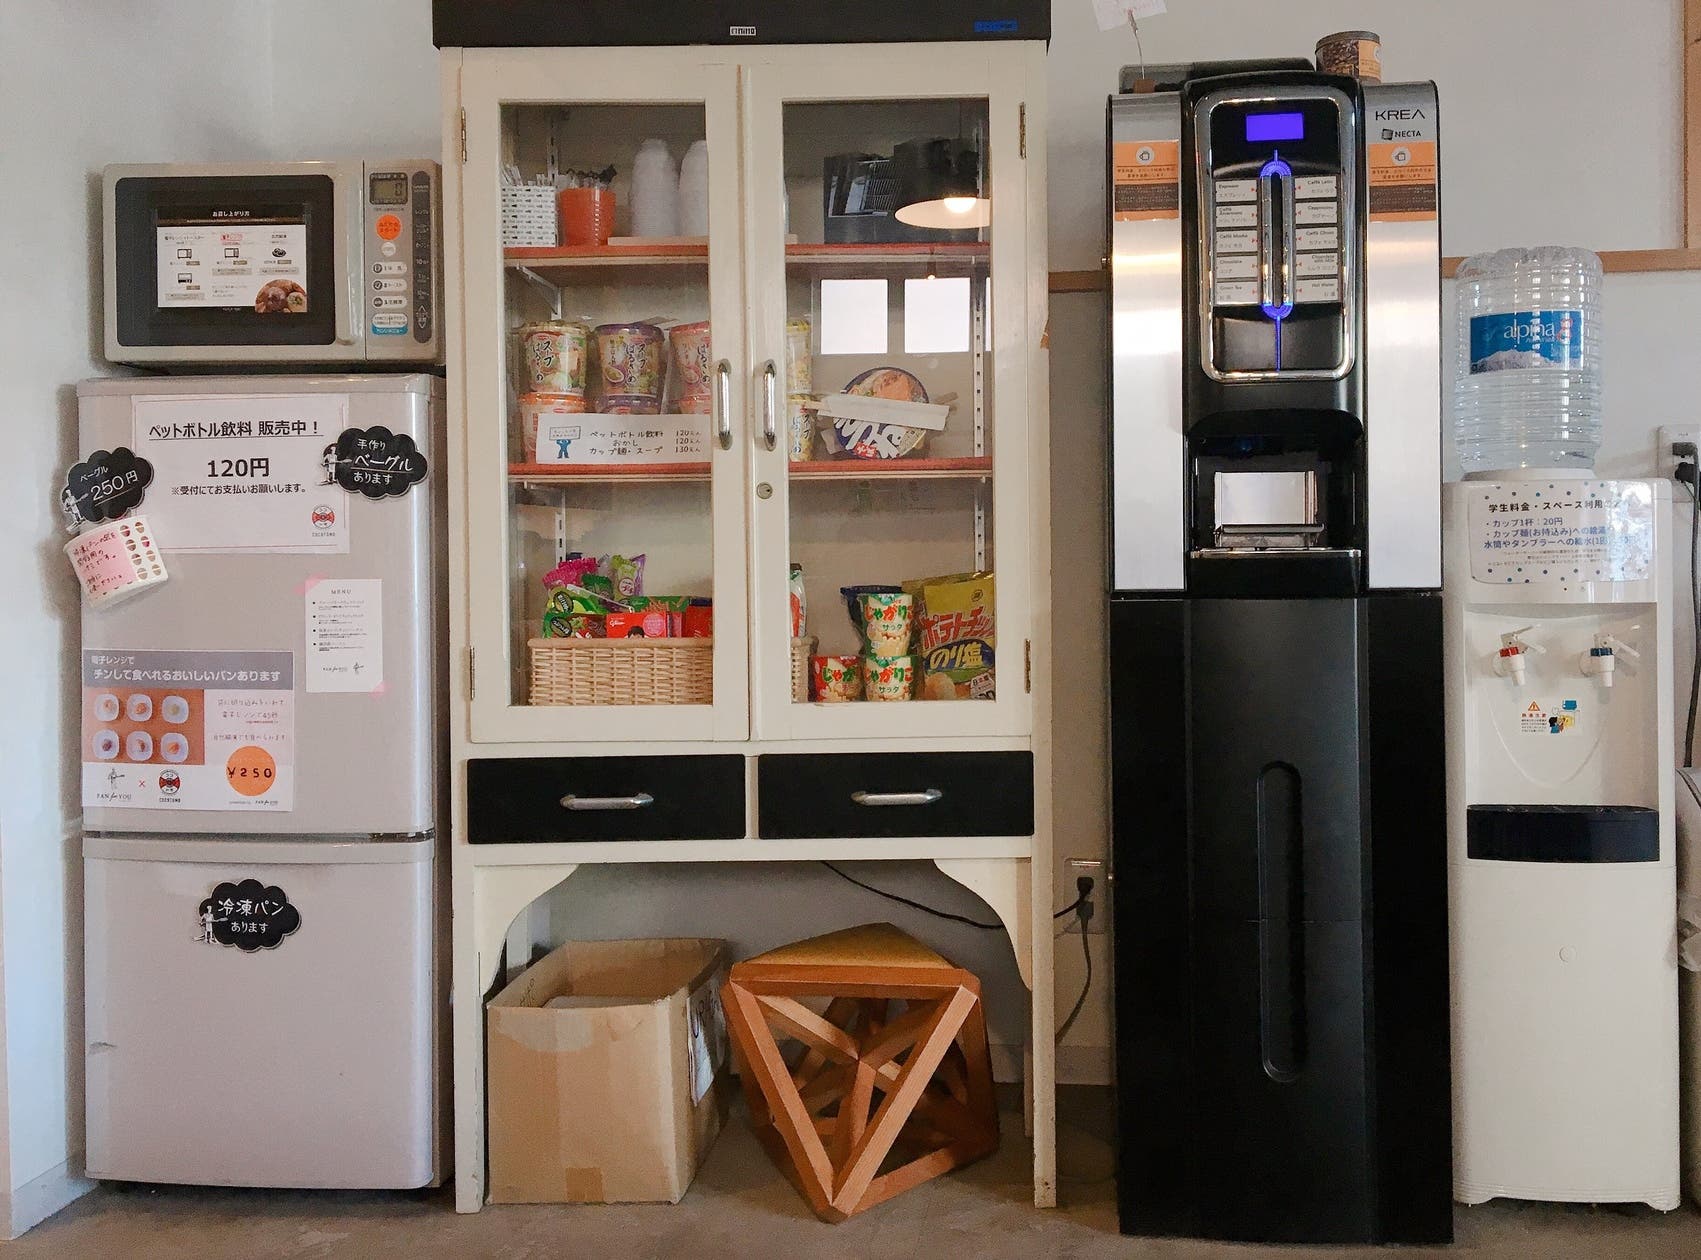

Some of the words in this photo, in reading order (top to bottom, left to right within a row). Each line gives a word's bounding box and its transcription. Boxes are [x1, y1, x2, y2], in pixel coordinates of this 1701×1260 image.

[1375, 109, 1425, 121] KREA
[1394, 130, 1421, 138] NECTA
[149, 421, 252, 439] ペットボトル飲料
[590, 430, 664, 438] ペットボトル飲料
[357, 439, 386, 451] 手作り
[207, 458, 270, 478] 120円
[355, 454, 414, 471] ベーグル
[80, 464, 109, 482] ベーグル
[353, 472, 393, 485] あります
[90, 469, 139, 500] 250円
[91, 655, 135, 665] 電子レンジで
[94, 668, 281, 682] チンして食べれるおいしいパンあります
[217, 898, 284, 916] 冷凍パン
[230, 921, 269, 934] あります
